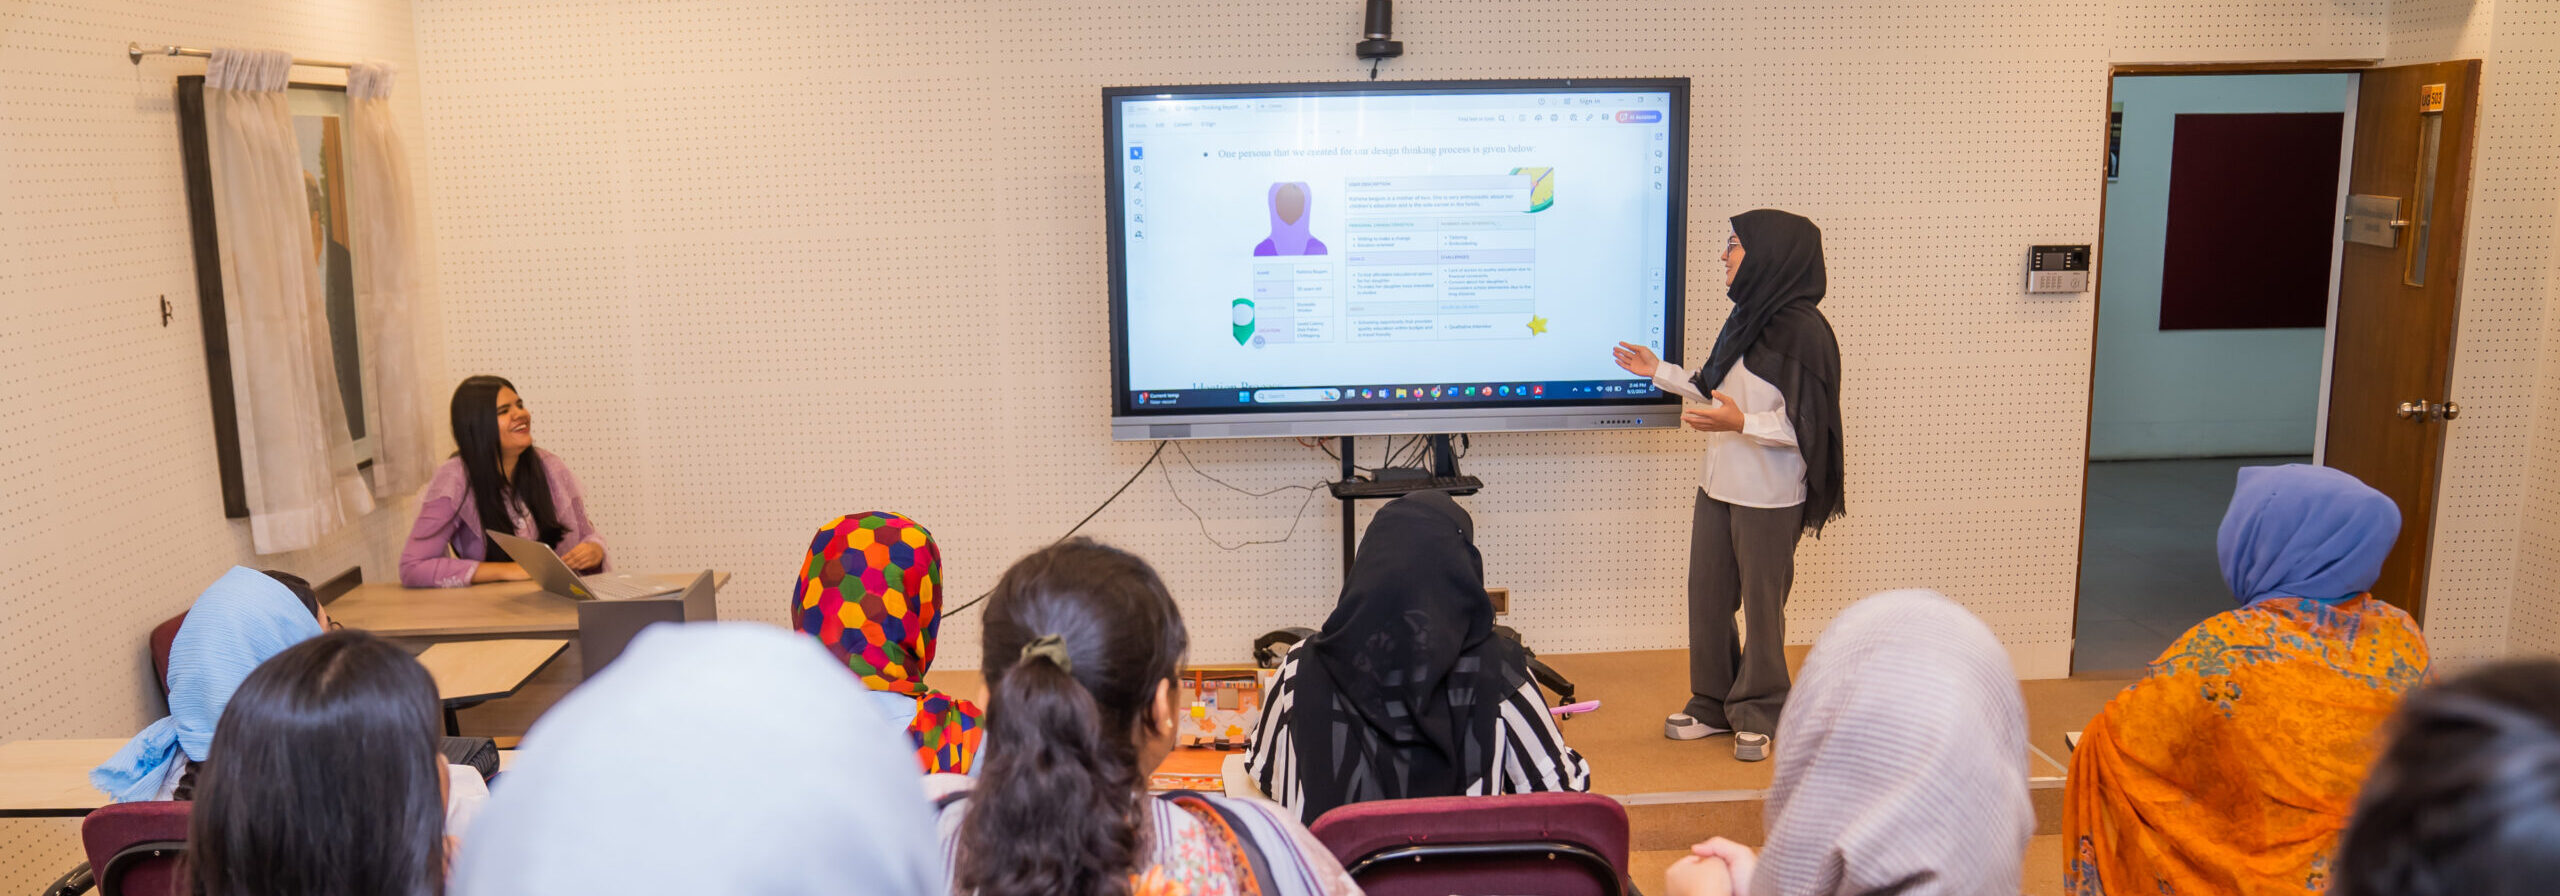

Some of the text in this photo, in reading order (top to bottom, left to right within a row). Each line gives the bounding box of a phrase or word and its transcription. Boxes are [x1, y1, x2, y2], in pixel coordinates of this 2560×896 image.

[1579, 97, 1593, 106] Sign
[2422, 91, 2442, 107] UG 503
[1201, 103, 1221, 112] Thinking
[1217, 149, 1237, 159] One
[1238, 150, 1272, 161] persona
[1273, 148, 1290, 158] that
[1291, 149, 1304, 157] we
[1306, 147, 1338, 157] created
[1339, 146, 1353, 157] for
[1370, 146, 1399, 158] design
[1401, 145, 1436, 157] thinking
[1438, 146, 1471, 157] process
[1472, 146, 1480, 154] is
[1482, 145, 1506, 156] given
[1507, 144, 1537, 154] below:
